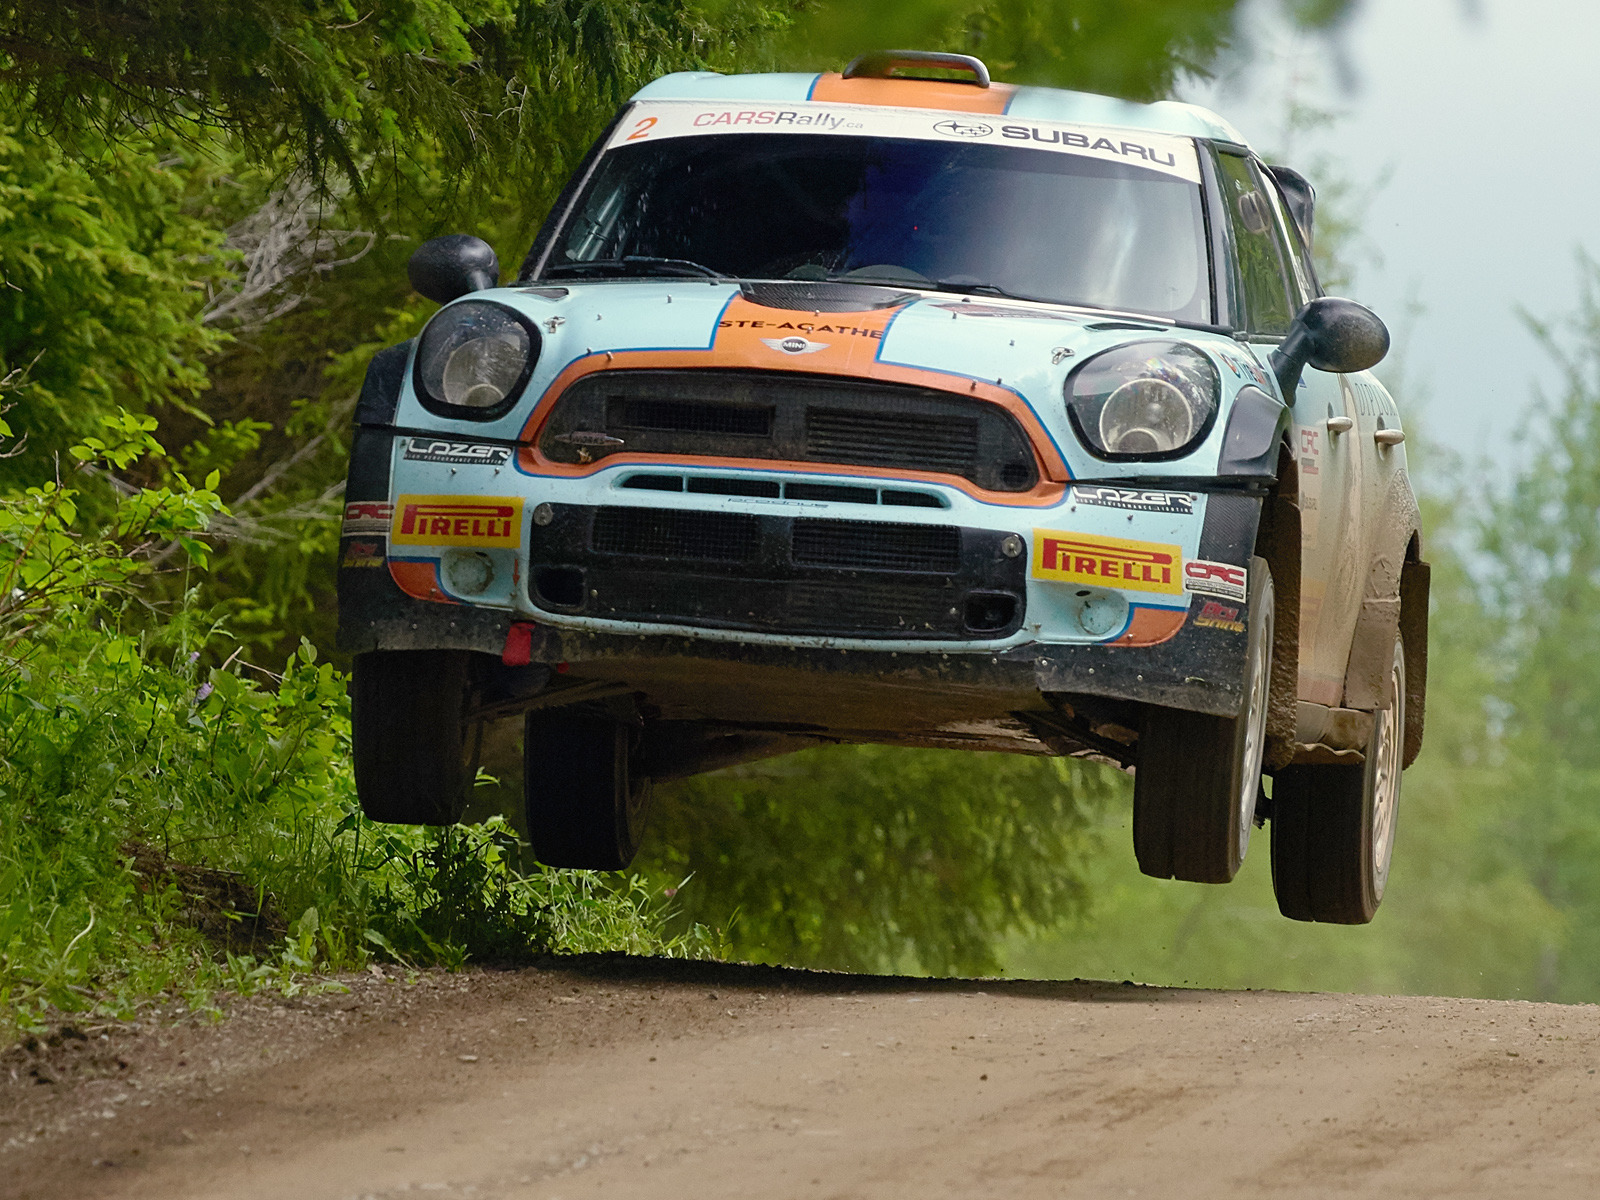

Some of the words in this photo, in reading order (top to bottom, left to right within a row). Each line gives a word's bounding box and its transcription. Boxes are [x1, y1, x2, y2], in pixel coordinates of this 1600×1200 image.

[626, 117, 658, 141] 2
[1001, 125, 1176, 167] SUBARU
[718, 320, 884, 339] STE-AGATHE
[782, 341, 806, 350] MINI
[408, 440, 512, 459] LAZER
[1072, 486, 1192, 506] LAZER
[401, 504, 515, 538] PIRELLI
[1042, 538, 1173, 584] PIRELLI
[1185, 562, 1245, 587] CRC
